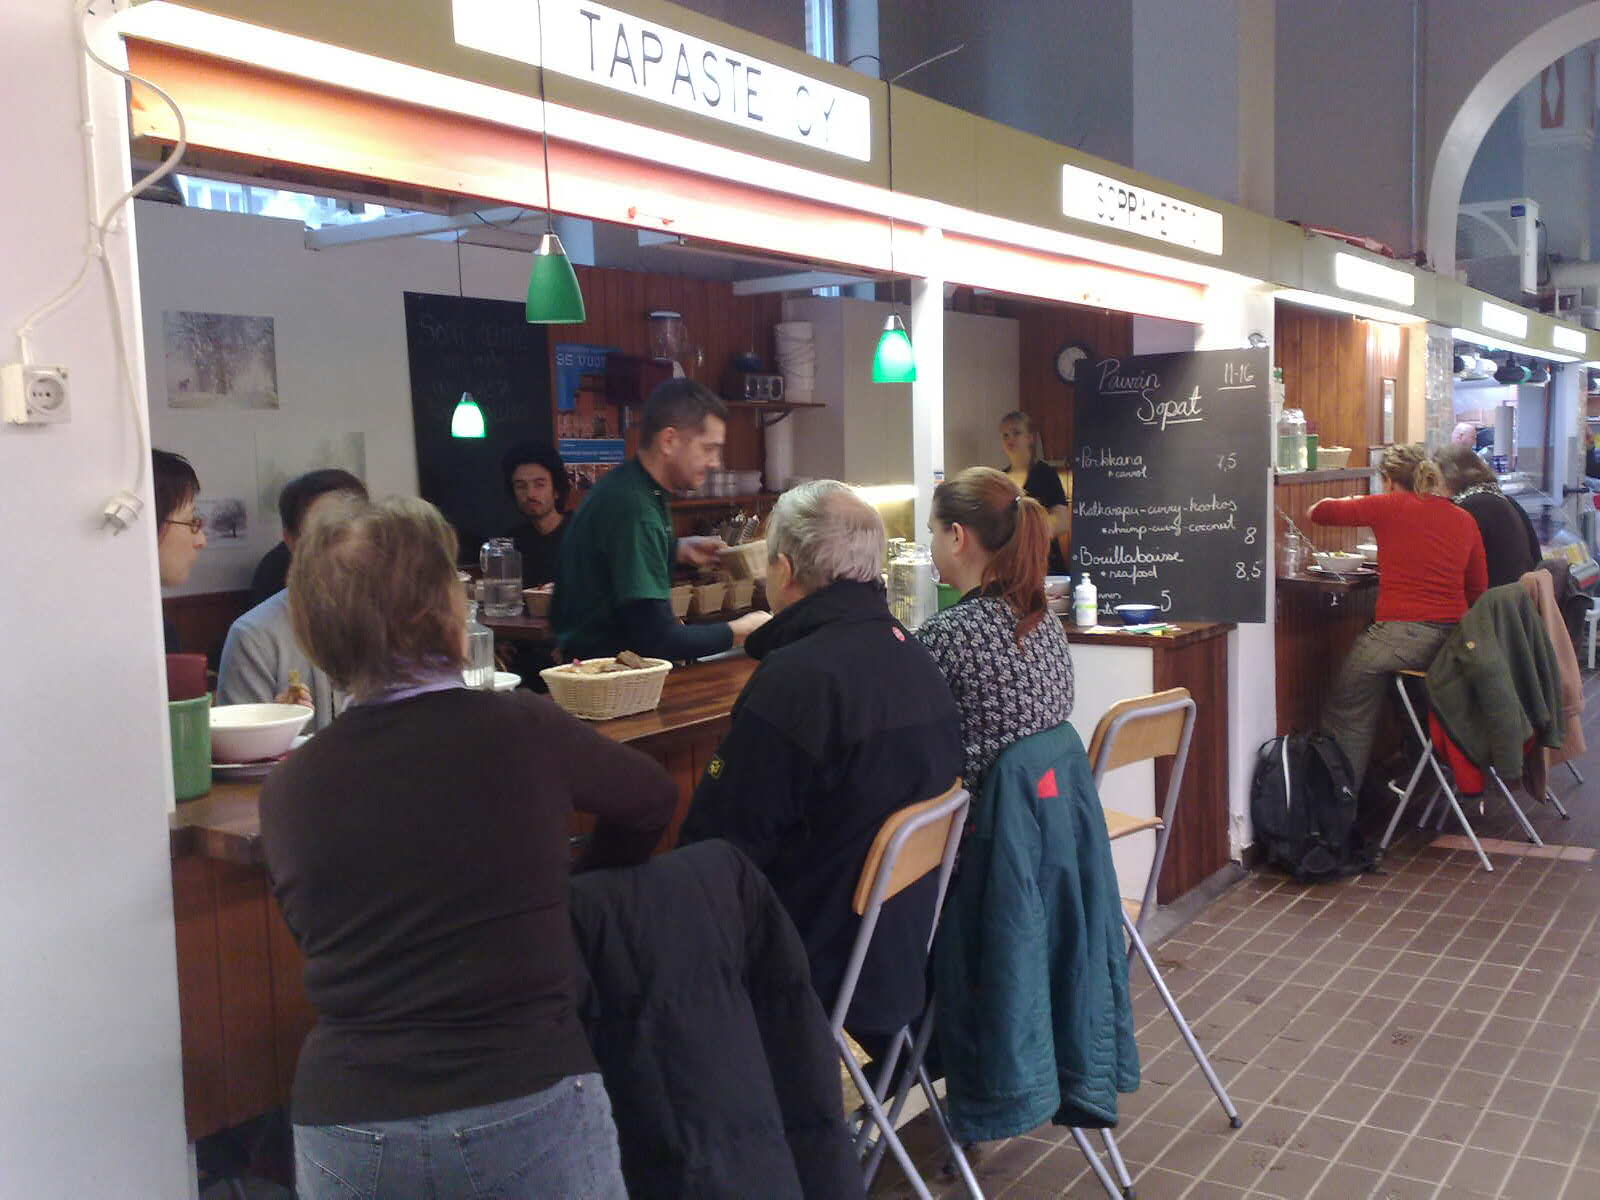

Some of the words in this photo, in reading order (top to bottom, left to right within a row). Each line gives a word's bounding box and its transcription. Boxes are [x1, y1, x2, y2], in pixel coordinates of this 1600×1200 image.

[579, 9, 763, 122] TAPASTE
[1224, 362, 1254, 385] 11-16
[1137, 385, 1203, 431] Sopat
[1081, 446, 1143, 469] Porkkana
[1243, 527, 1257, 545] 8
[1080, 545, 1184, 566] Bouillabaisse
[1109, 564, 1158, 585] seafood
[1235, 560, 1262, 581] 8,5
[1160, 590, 1172, 612] 5
